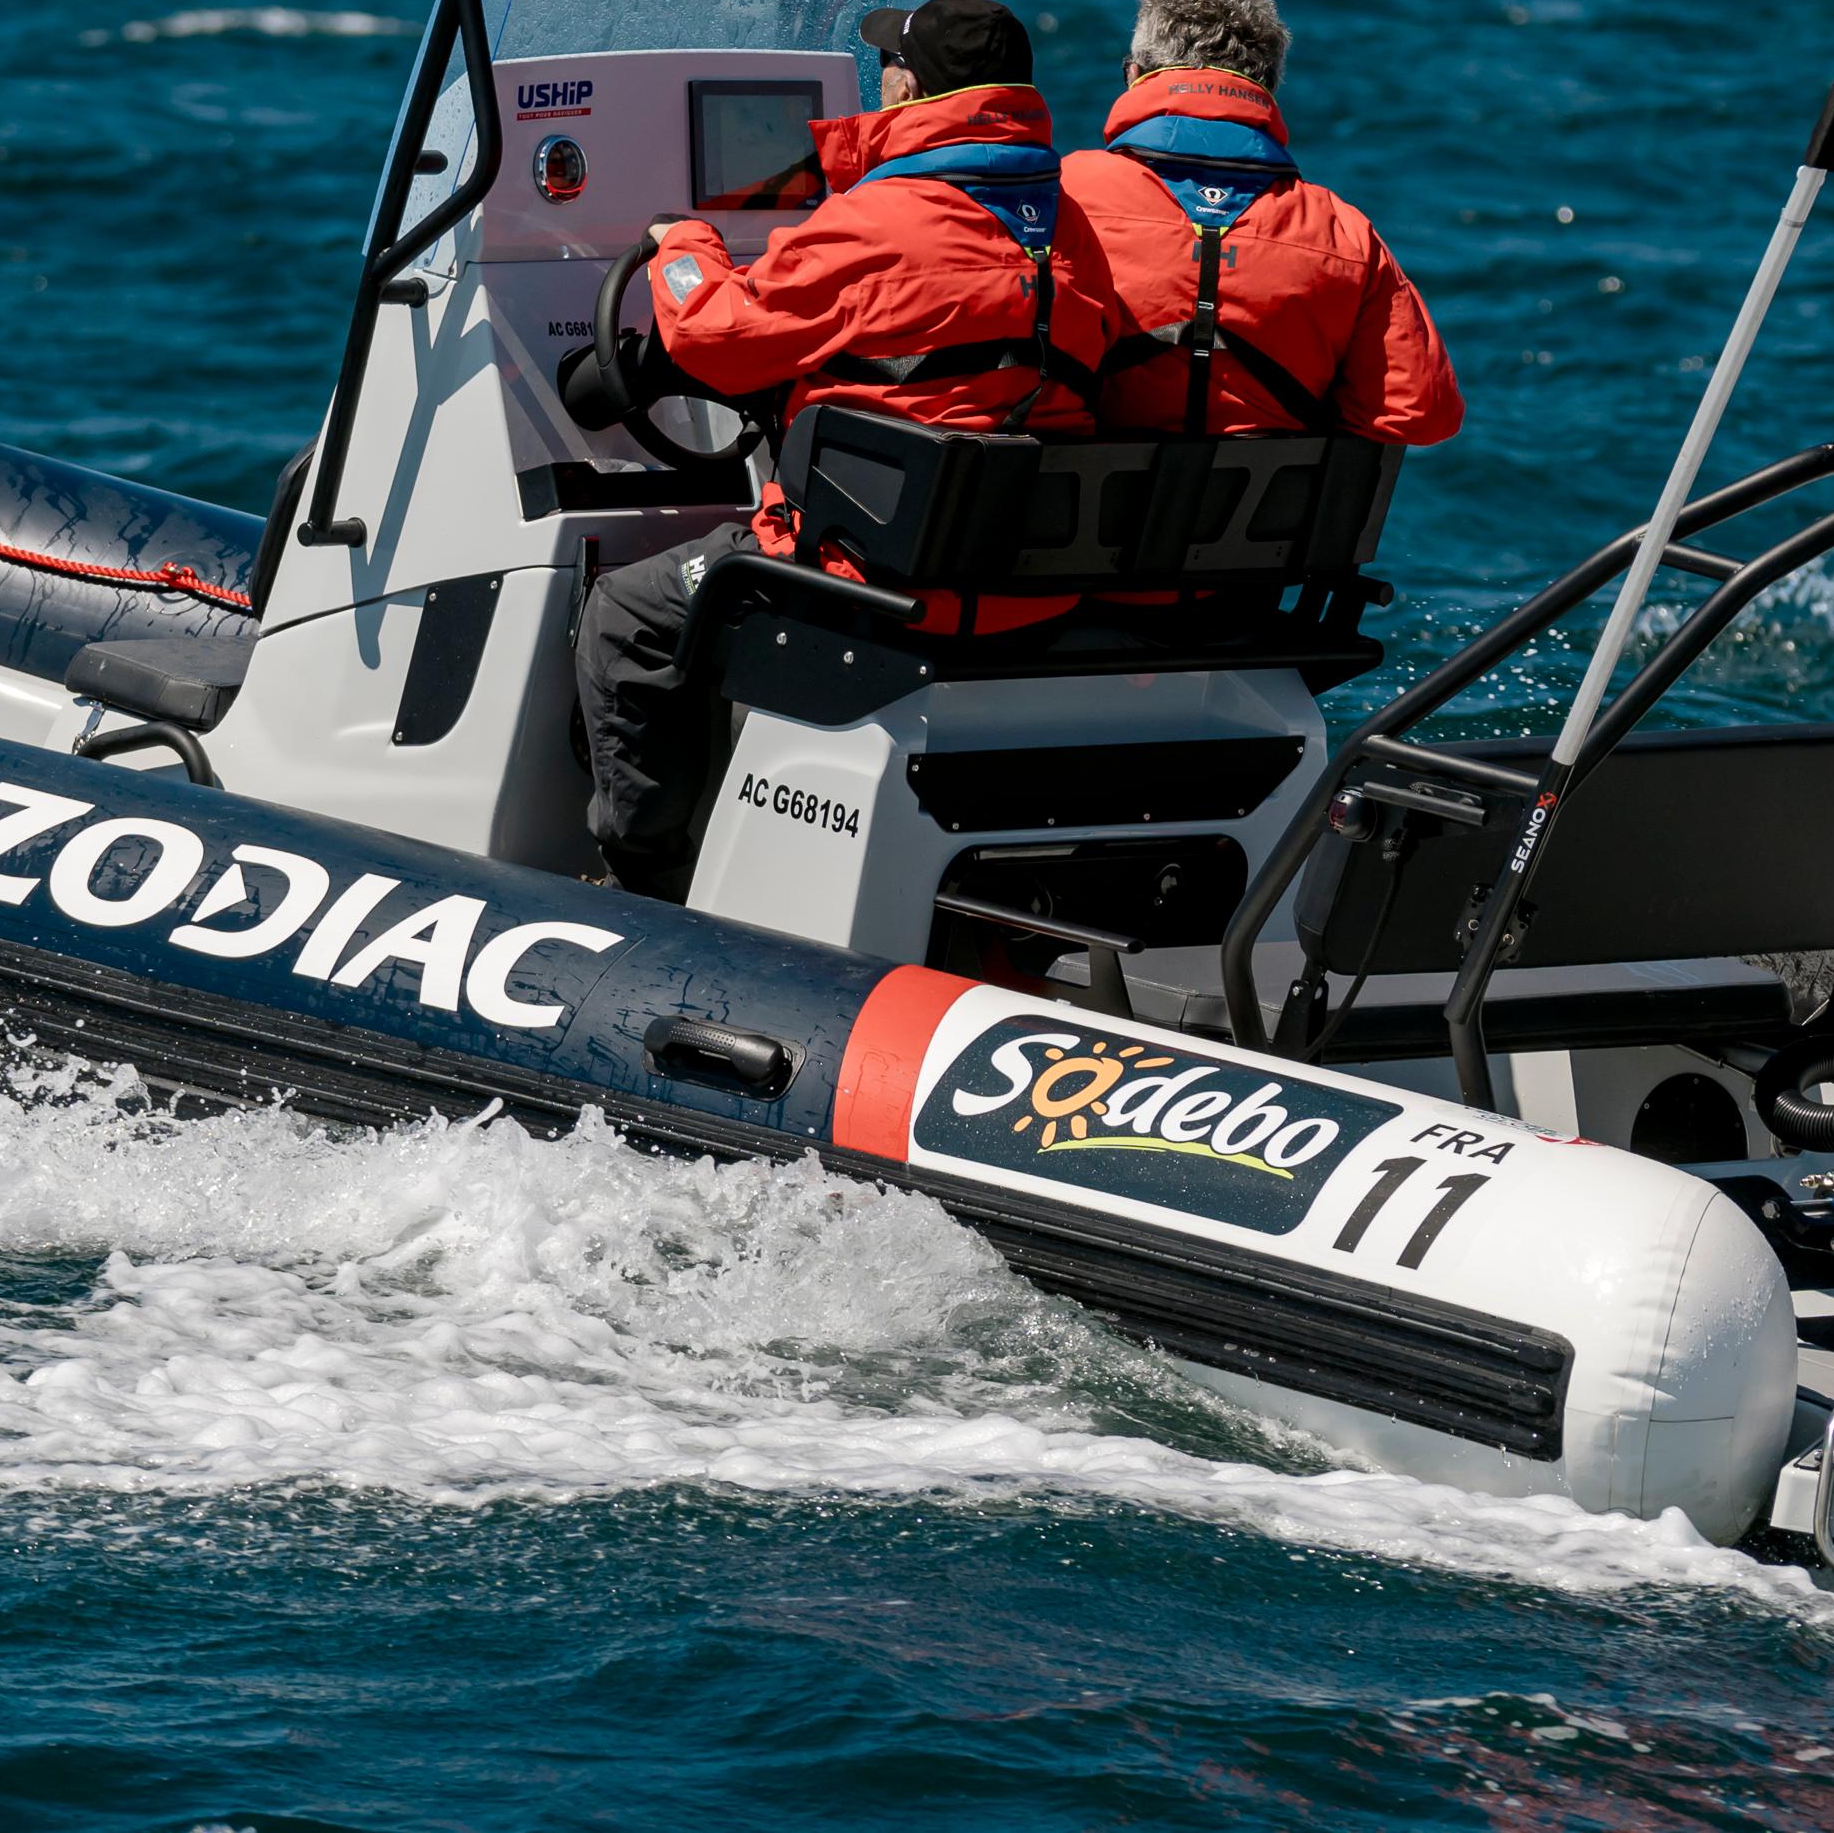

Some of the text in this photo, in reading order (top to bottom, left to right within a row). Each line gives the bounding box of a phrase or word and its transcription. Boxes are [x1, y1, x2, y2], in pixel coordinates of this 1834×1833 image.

[1168, 83, 1214, 96] HELLY
[548, 321, 594, 336] AC G681
[738, 773, 861, 839] AC G68194
[1409, 1123, 1516, 1165] FRA
[1332, 1156, 1492, 1270] 11
